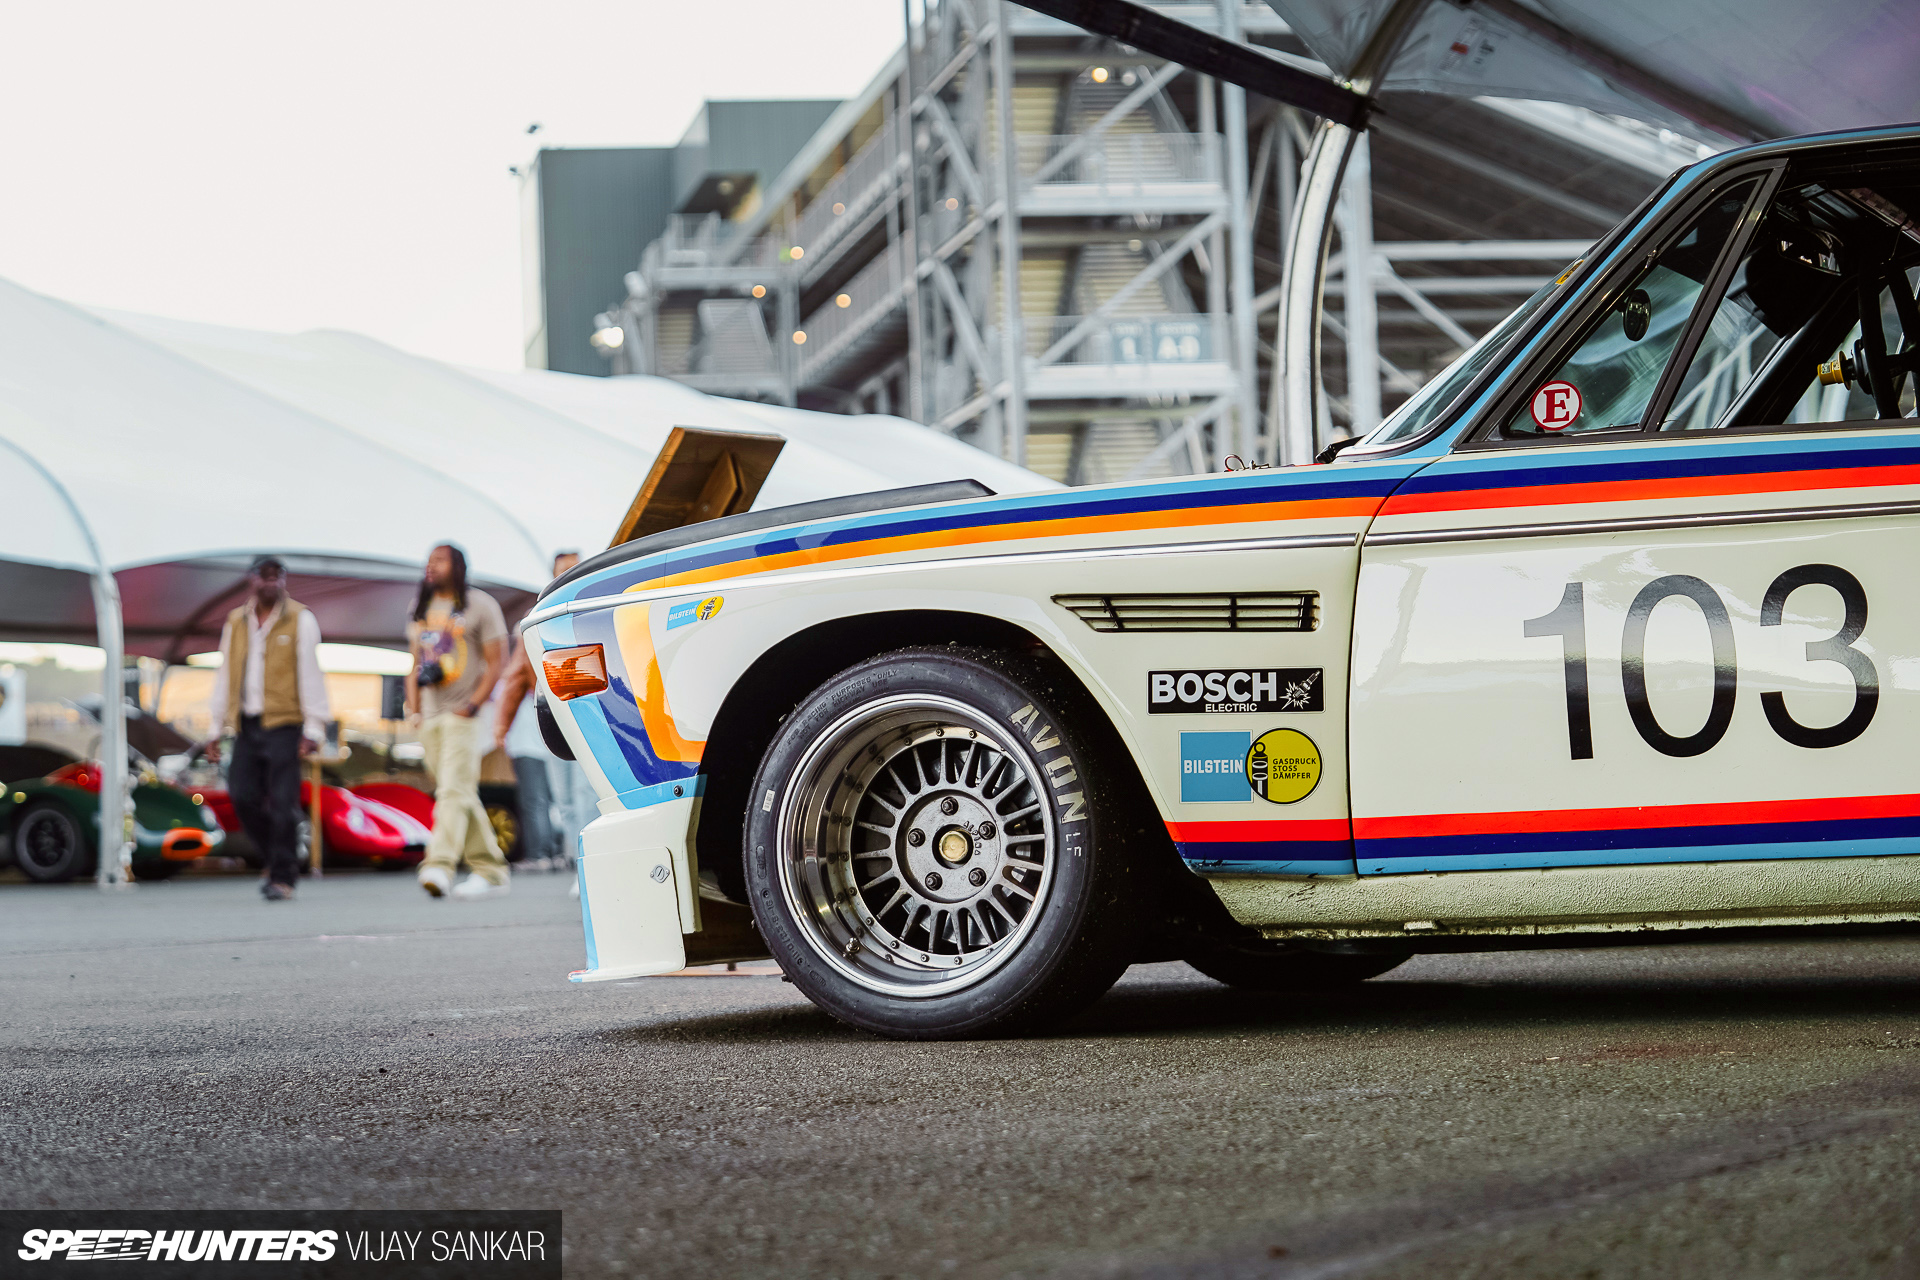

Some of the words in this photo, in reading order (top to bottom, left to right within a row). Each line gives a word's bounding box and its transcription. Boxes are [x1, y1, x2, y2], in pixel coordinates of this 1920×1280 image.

[1542, 388, 1571, 424] E
[1523, 563, 1880, 761] 103
[1151, 671, 1277, 703] BOSCH
[787, 727, 800, 746] FOR
[801, 702, 827, 727] RACING
[831, 676, 871, 701] PURPOSES
[877, 669, 899, 680] ONLY
[815, 708, 829, 722] FOR
[832, 686, 865, 707] HIGHWAY
[1205, 702, 1258, 713] ELECTRIC
[1007, 702, 1088, 825] AVON
[1183, 759, 1244, 774] BILSTEIN
[1272, 757, 1317, 766] GASDRUCK
[1272, 764, 1298, 772] STOSS
[1272, 771, 1312, 780] DÄMPFER
